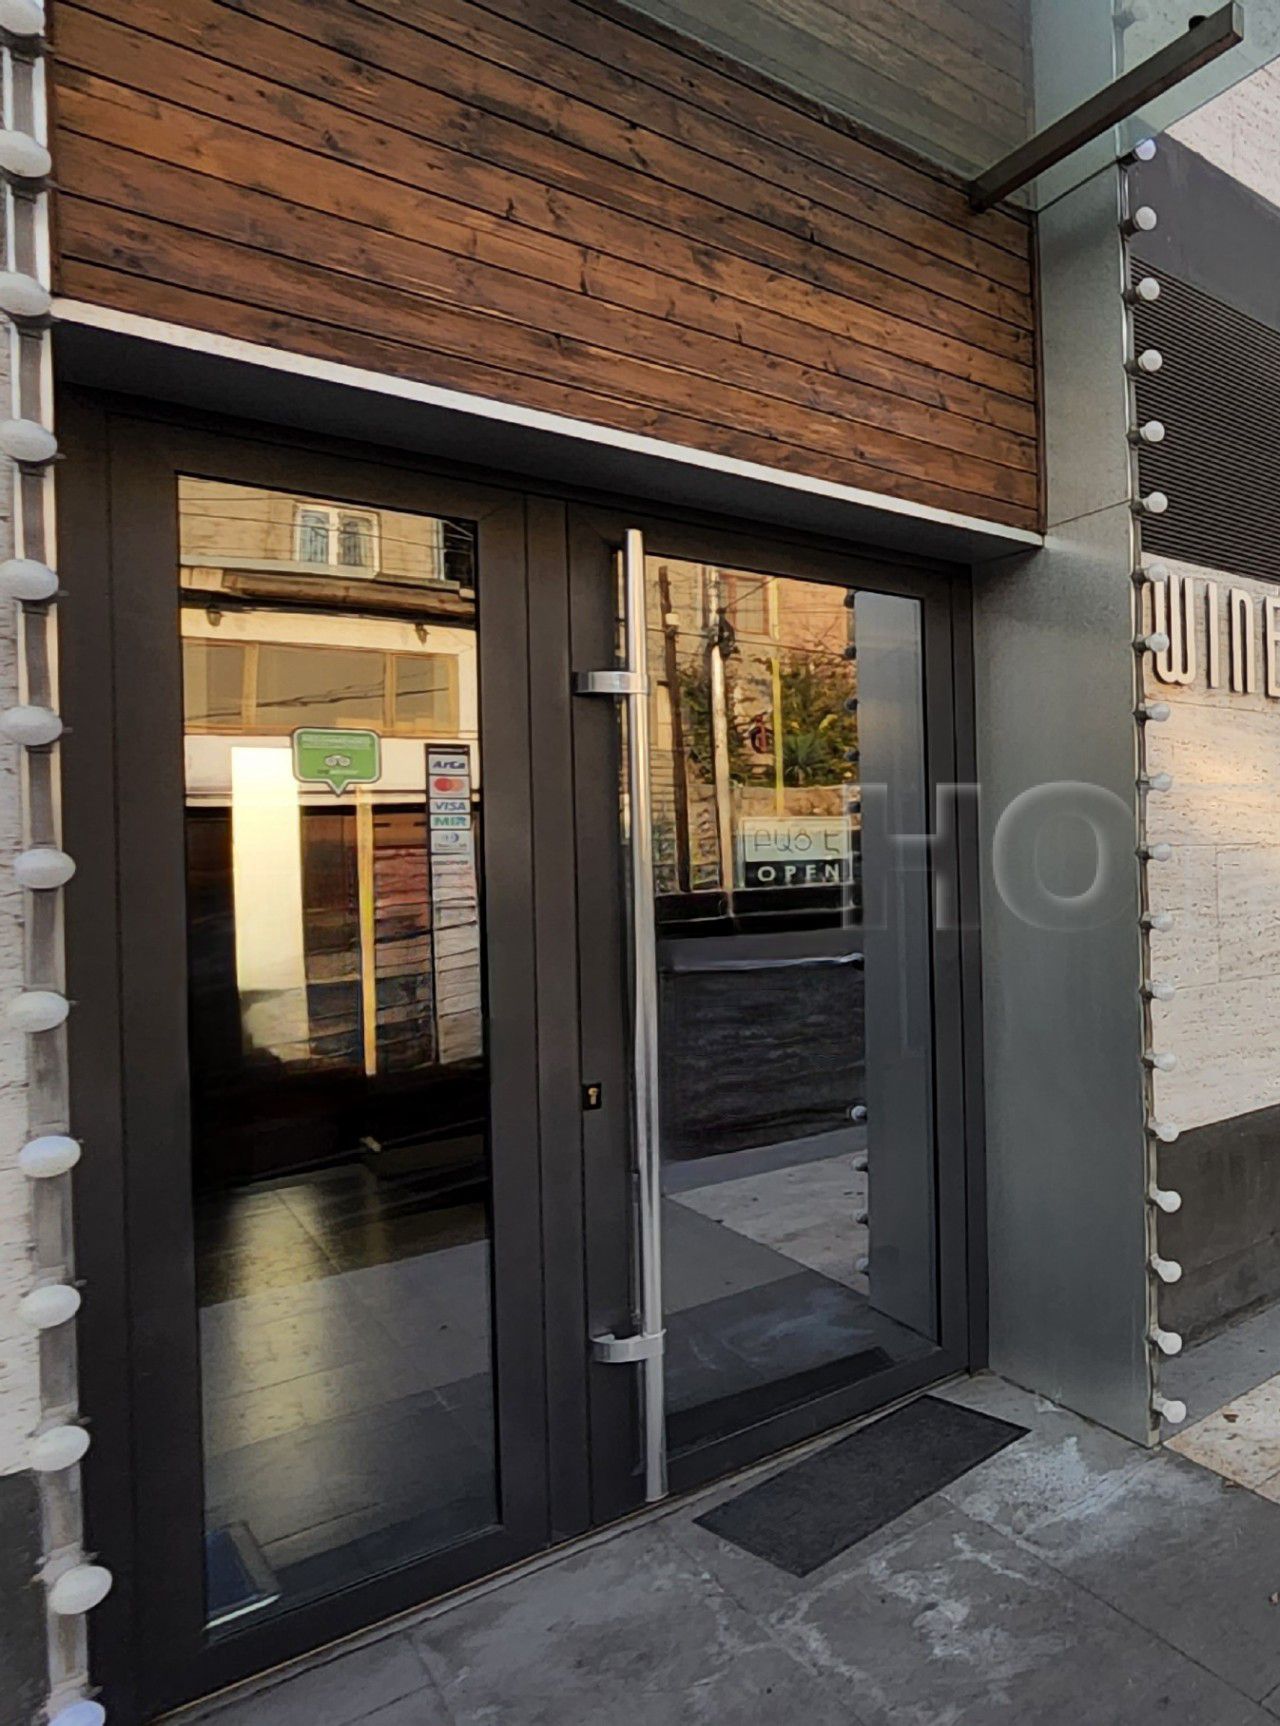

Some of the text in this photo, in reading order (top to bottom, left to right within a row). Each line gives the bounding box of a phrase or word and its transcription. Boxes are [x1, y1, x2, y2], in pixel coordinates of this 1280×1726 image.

[435, 802, 466, 811] VISA
[433, 816, 466, 826] MIR
[757, 863, 840, 885] OPEN
